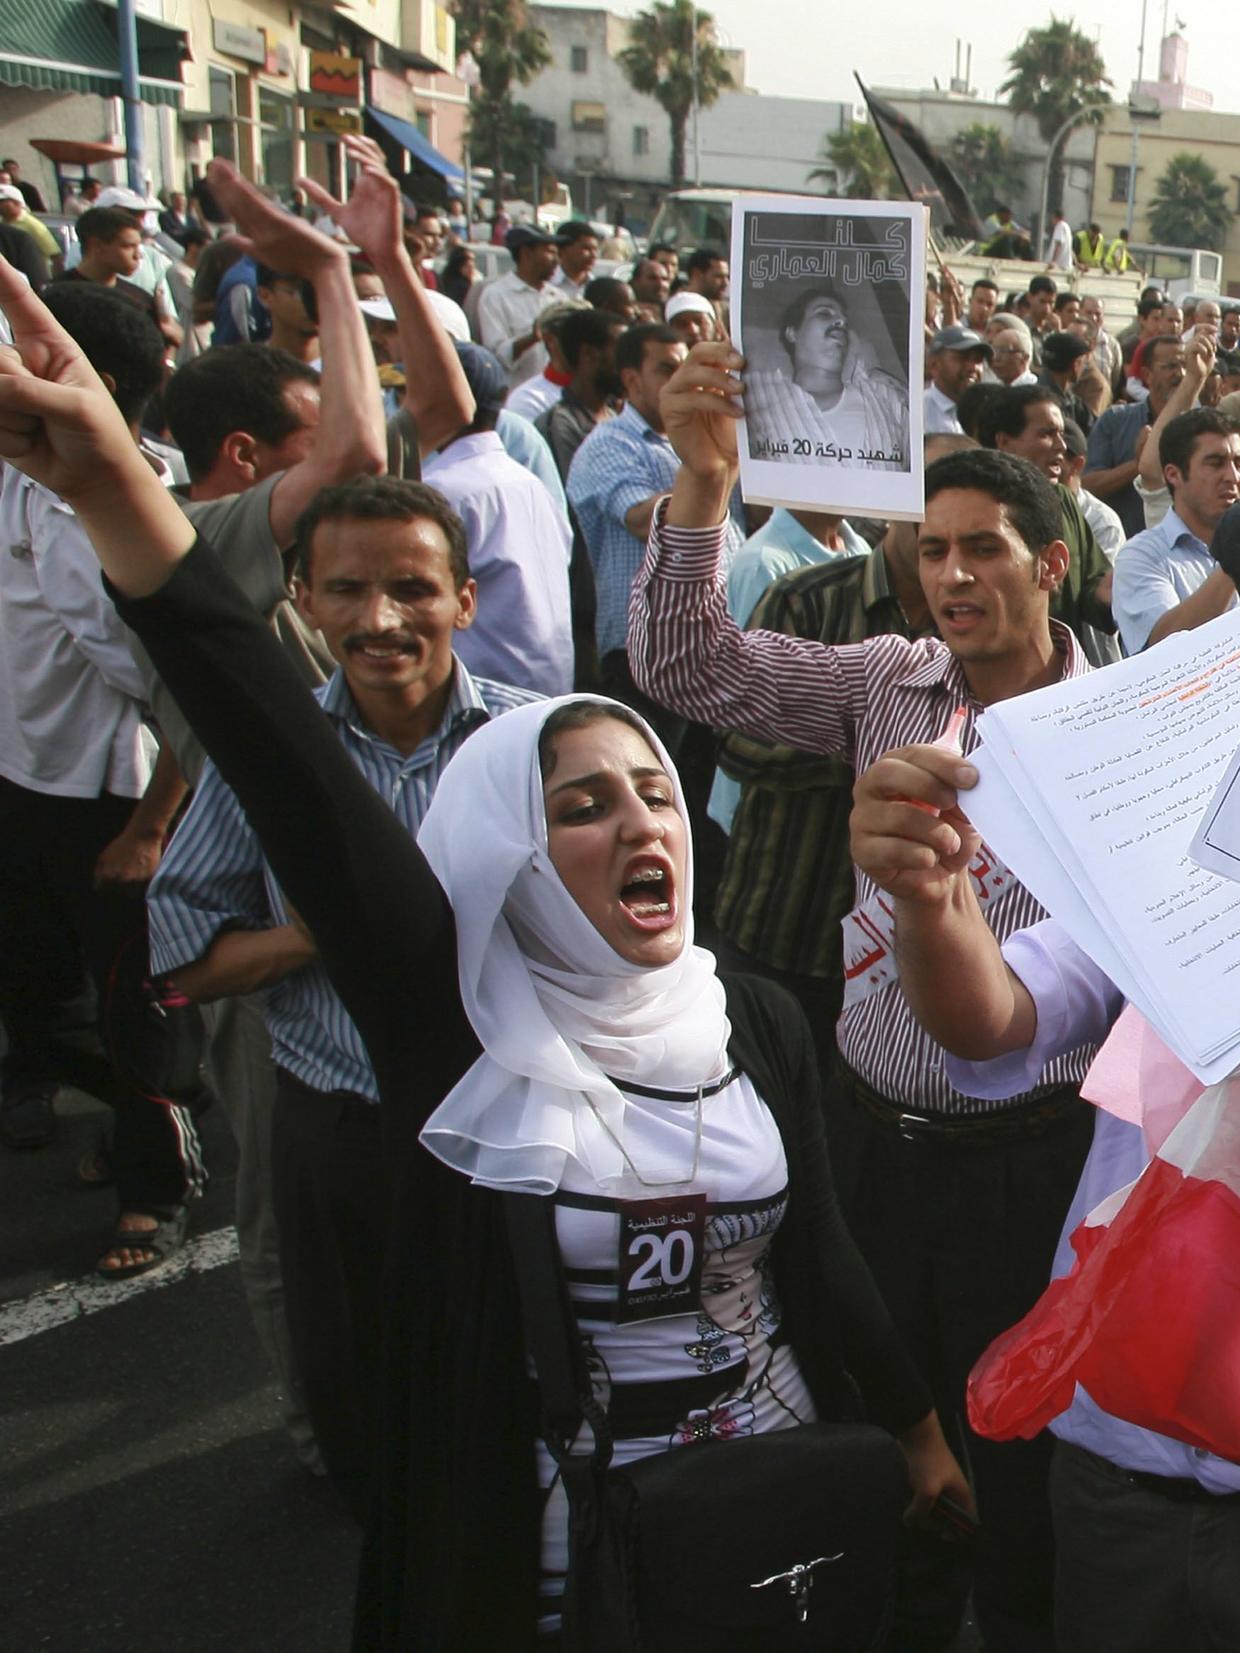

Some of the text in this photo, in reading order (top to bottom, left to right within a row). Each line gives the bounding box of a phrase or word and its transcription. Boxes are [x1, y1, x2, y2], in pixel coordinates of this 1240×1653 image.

[750, 248, 907, 288] كمال العماري
[753, 438, 904, 464] شهيد حركة 20 فبراير
[628, 1229, 694, 1291] 20
